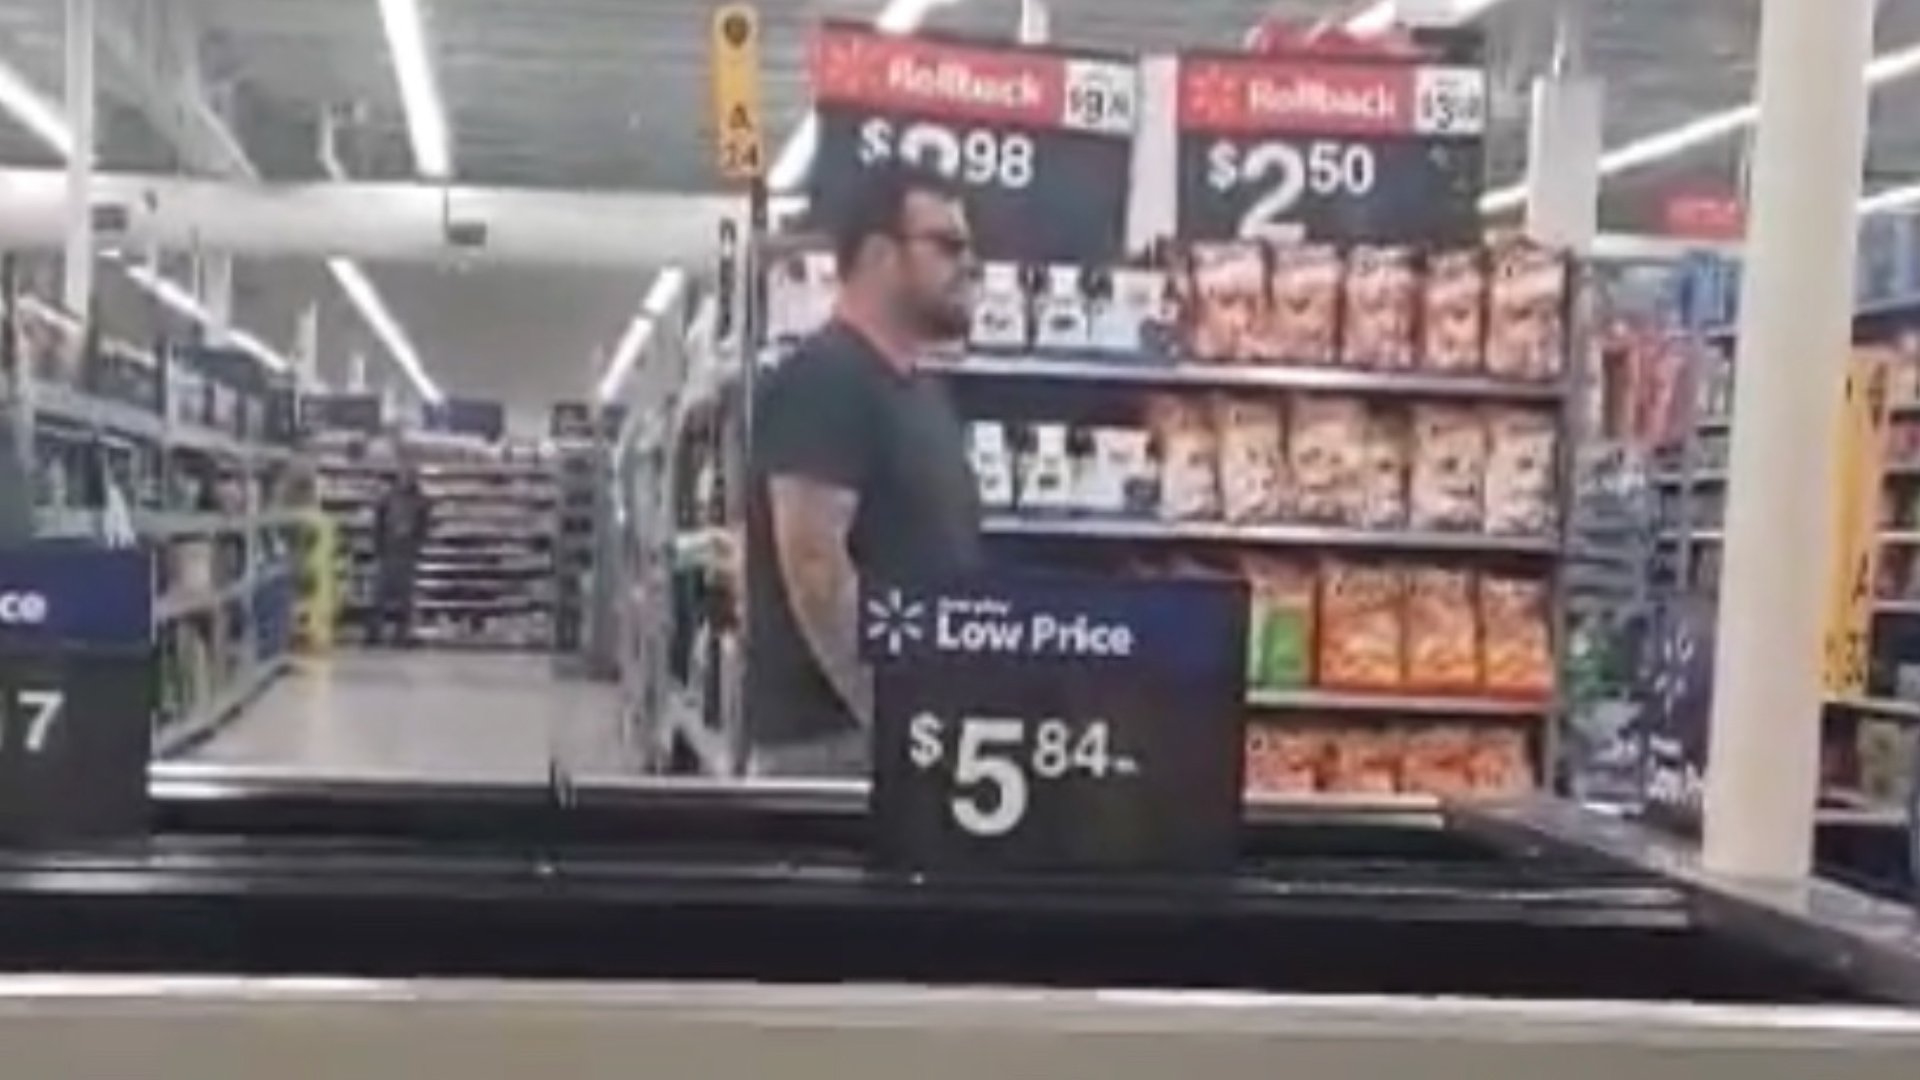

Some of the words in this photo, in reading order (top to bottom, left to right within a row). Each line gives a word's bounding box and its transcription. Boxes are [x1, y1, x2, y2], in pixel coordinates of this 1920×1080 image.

[1249, 79, 1397, 119] Rollback
[936, 614, 1023, 650] Low
[1031, 614, 1133, 656] Price
[0, 689, 63, 751] 7
